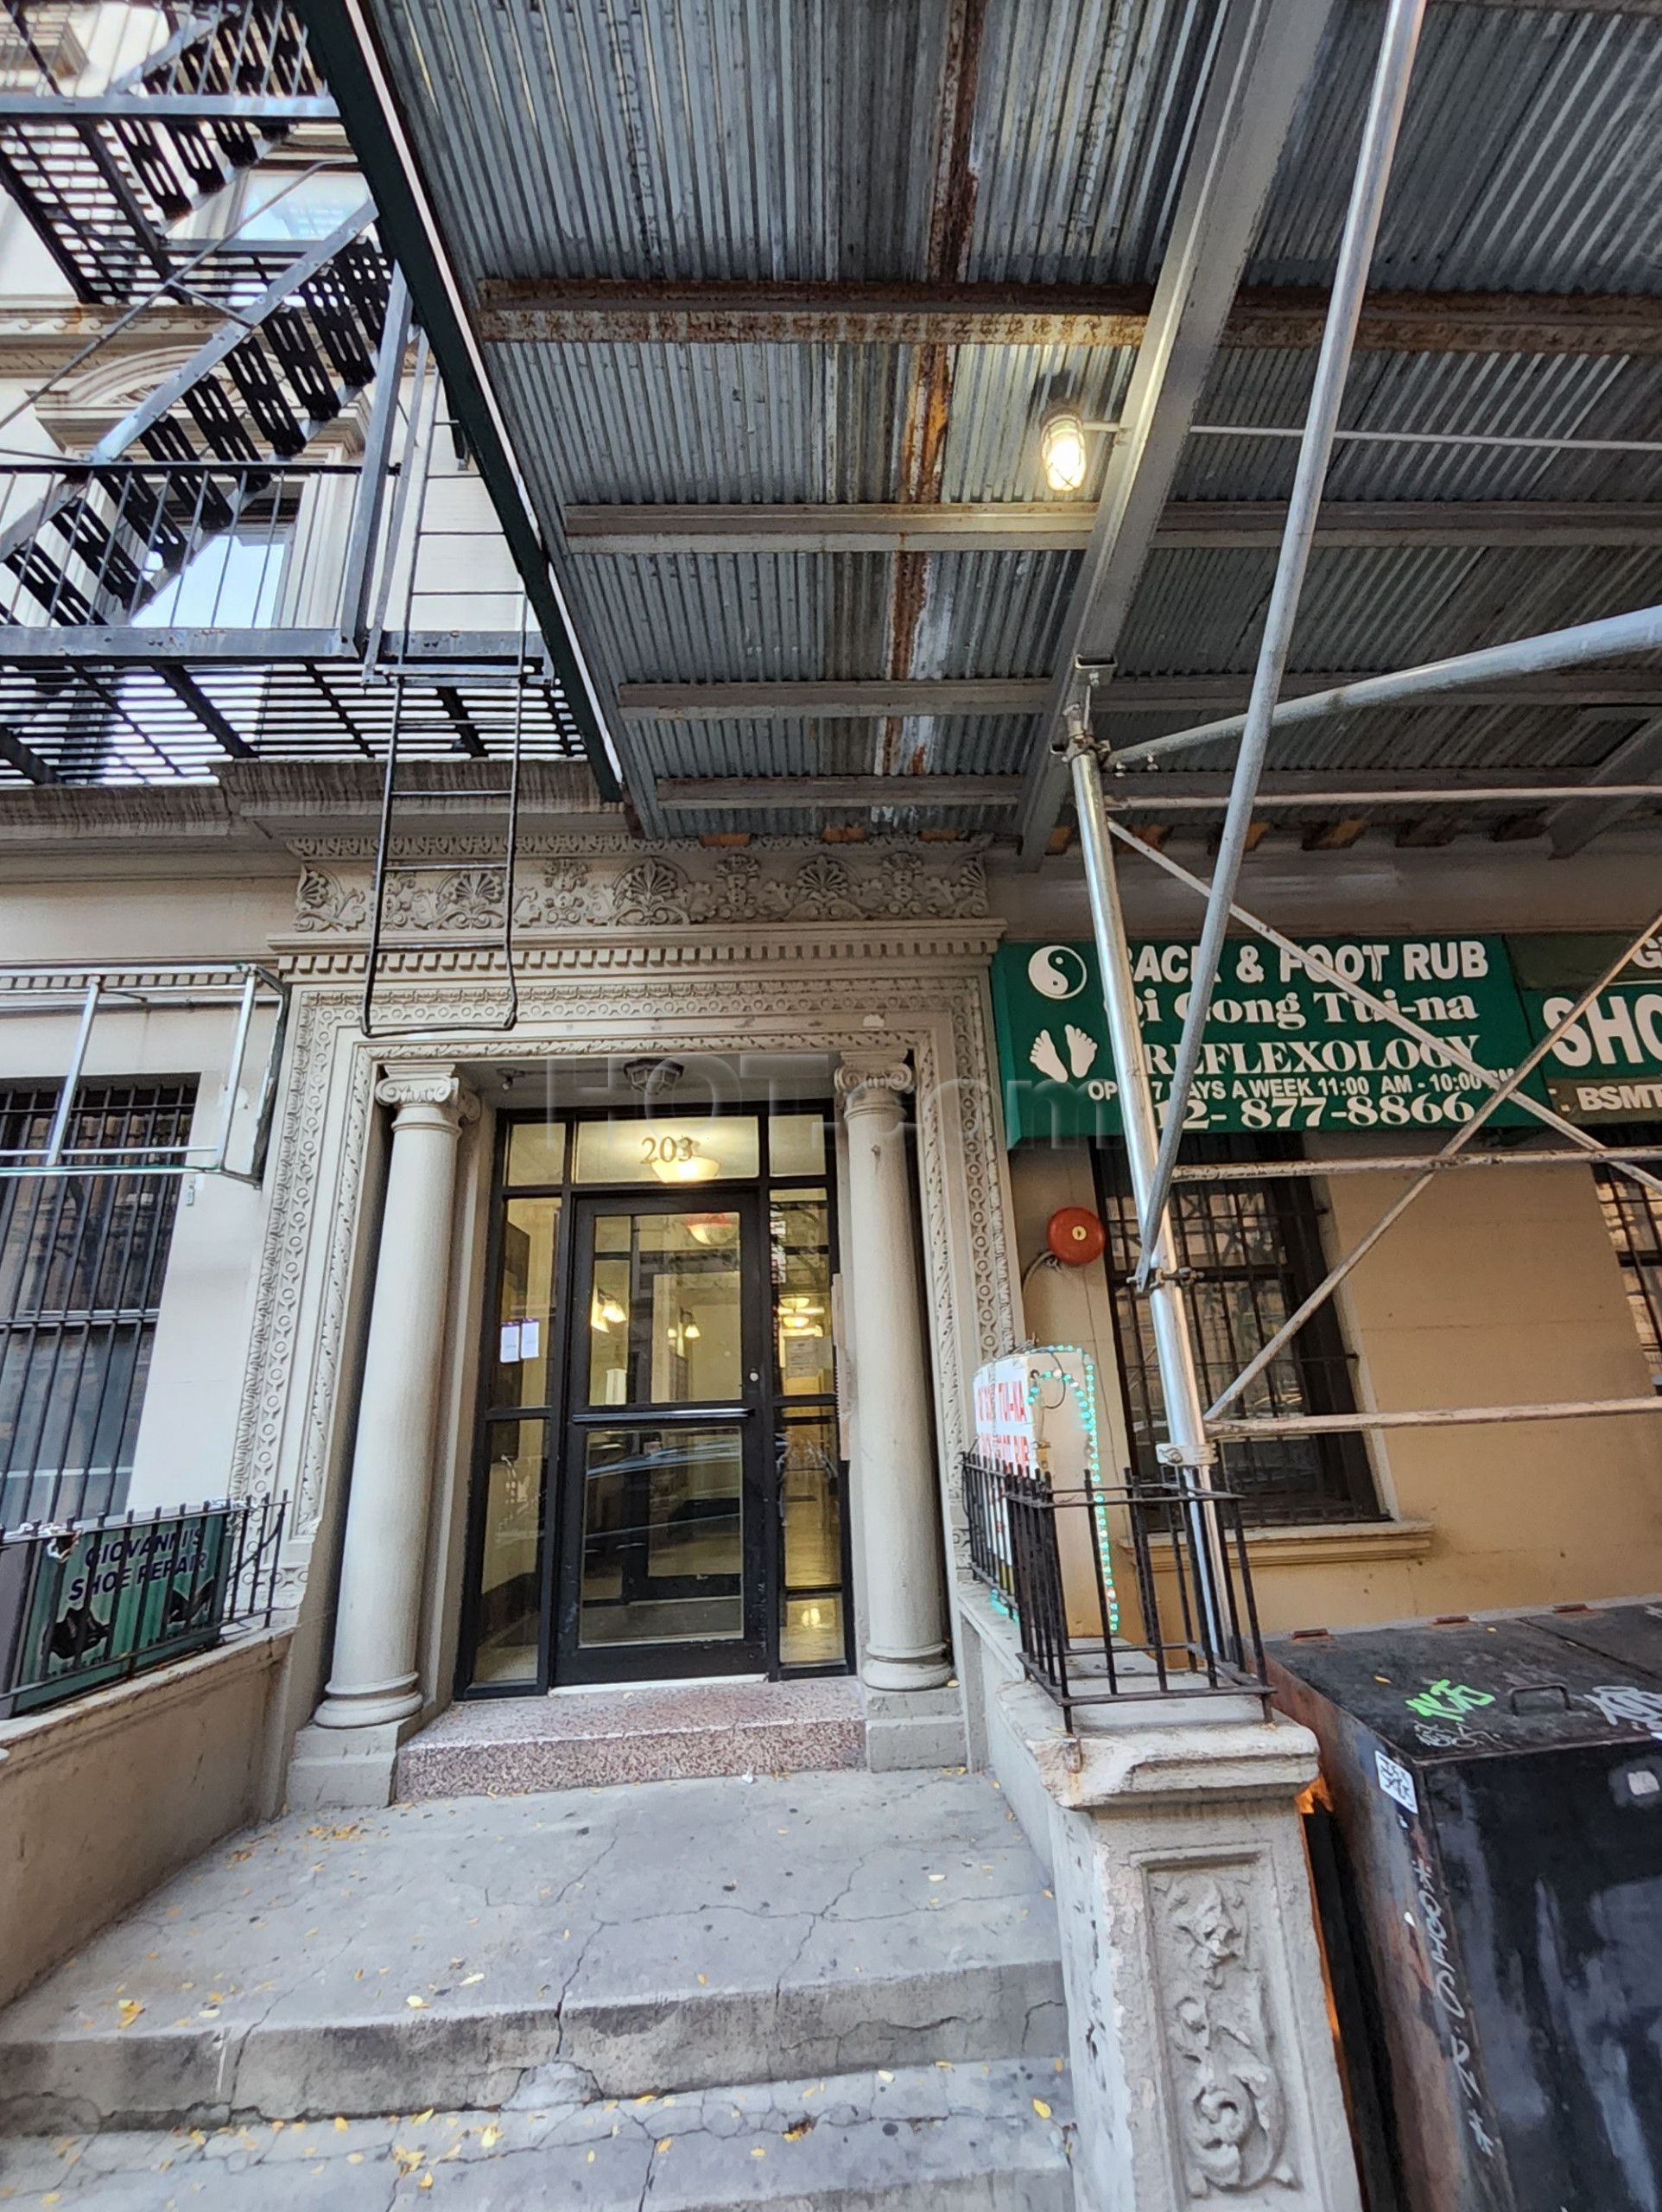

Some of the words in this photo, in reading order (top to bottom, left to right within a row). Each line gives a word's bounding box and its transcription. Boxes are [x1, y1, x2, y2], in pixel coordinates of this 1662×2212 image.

[1124, 945, 1221, 983] AC
[1236, 946, 1264, 982] &
[1279, 945, 1390, 983] FOOT
[1404, 941, 1488, 981] RUB
[1151, 1081, 1163, 1100] 7
[1170, 1080, 1226, 1100] AYS
[1232, 1080, 1248, 1098] A
[1248, 1078, 1311, 1098] WEEK
[1318, 1076, 1370, 1096] 11:00
[1381, 1074, 1412, 1094] AM
[1429, 1071, 1482, 1092] 10:00
[1154, 1099, 1227, 1129] 12-
[1241, 1091, 1475, 1129] 877-8866
[640, 1136, 693, 1164] 203
[68, 1567, 132, 1601] SHOE
